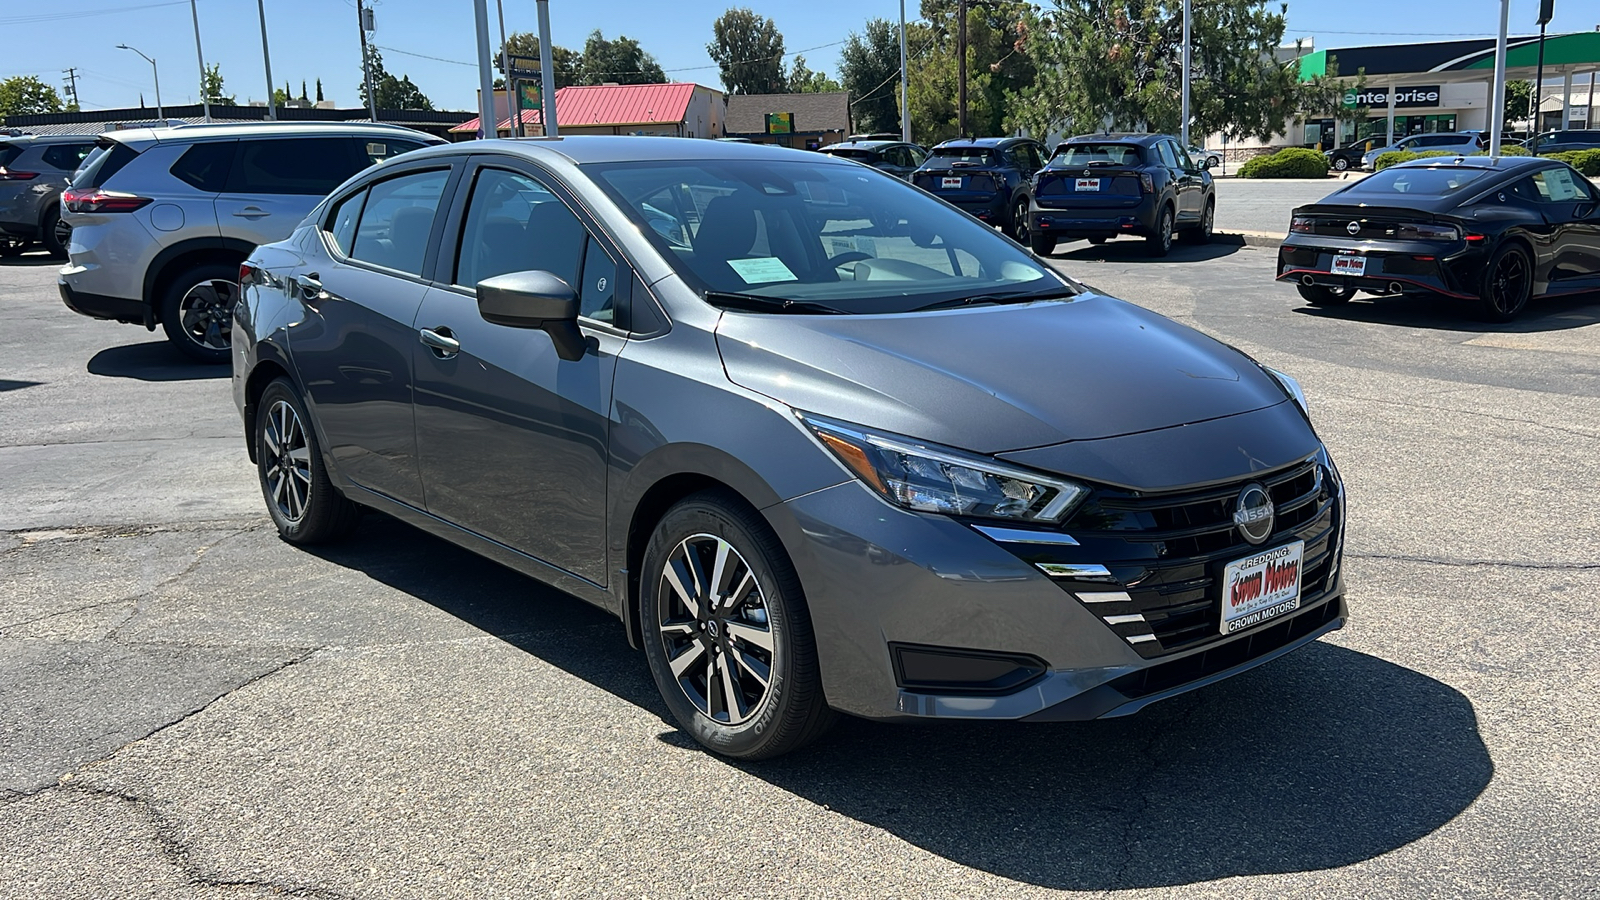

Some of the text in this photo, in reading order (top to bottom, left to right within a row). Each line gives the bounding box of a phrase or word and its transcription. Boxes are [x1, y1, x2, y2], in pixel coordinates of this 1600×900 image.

[1234, 501, 1274, 523] NISSAN
[1246, 548, 1287, 568] REDDING
[1231, 559, 1298, 607] Crown Motors
[1229, 600, 1296, 631] CROWN MOTORS
[754, 674, 783, 735] KUMHO
